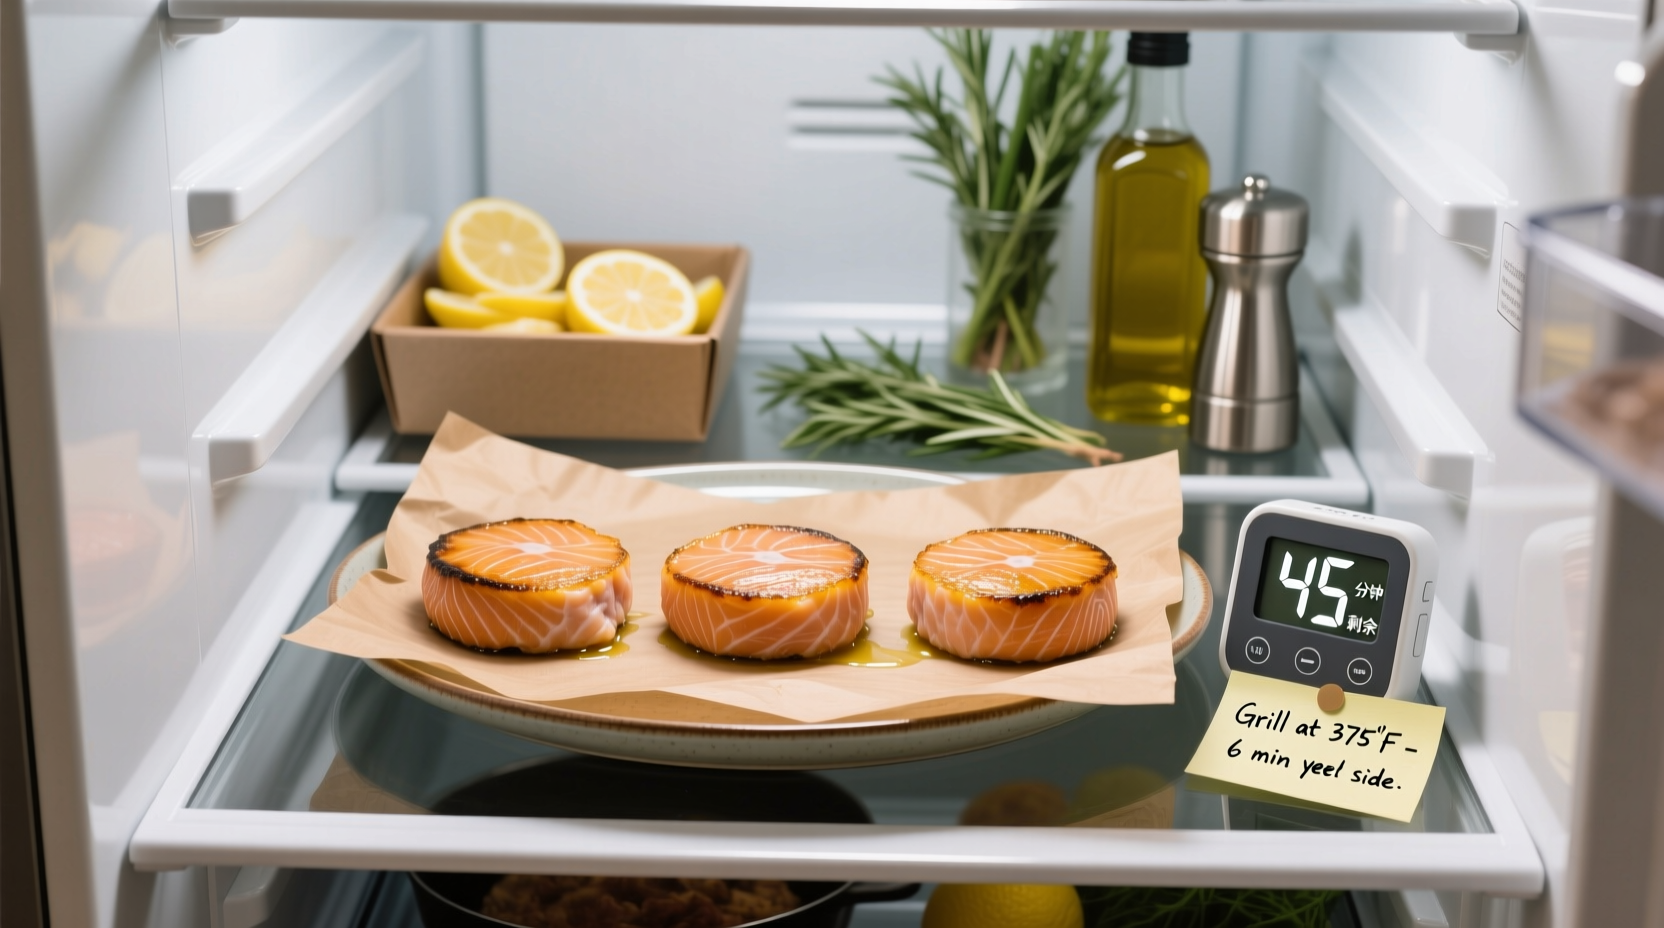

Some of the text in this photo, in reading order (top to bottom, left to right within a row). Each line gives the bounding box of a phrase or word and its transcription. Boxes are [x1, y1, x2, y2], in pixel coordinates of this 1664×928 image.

[1279, 551, 1355, 628] 45
[1355, 582, 1384, 600] 分钟
[1346, 614, 1378, 636] 剩余
[1235, 702, 1290, 733] Grill
[1295, 718, 1321, 738] at
[1227, 739, 1242, 758] 6
[1251, 749, 1290, 768] min
[1351, 769, 1402, 790] side.
